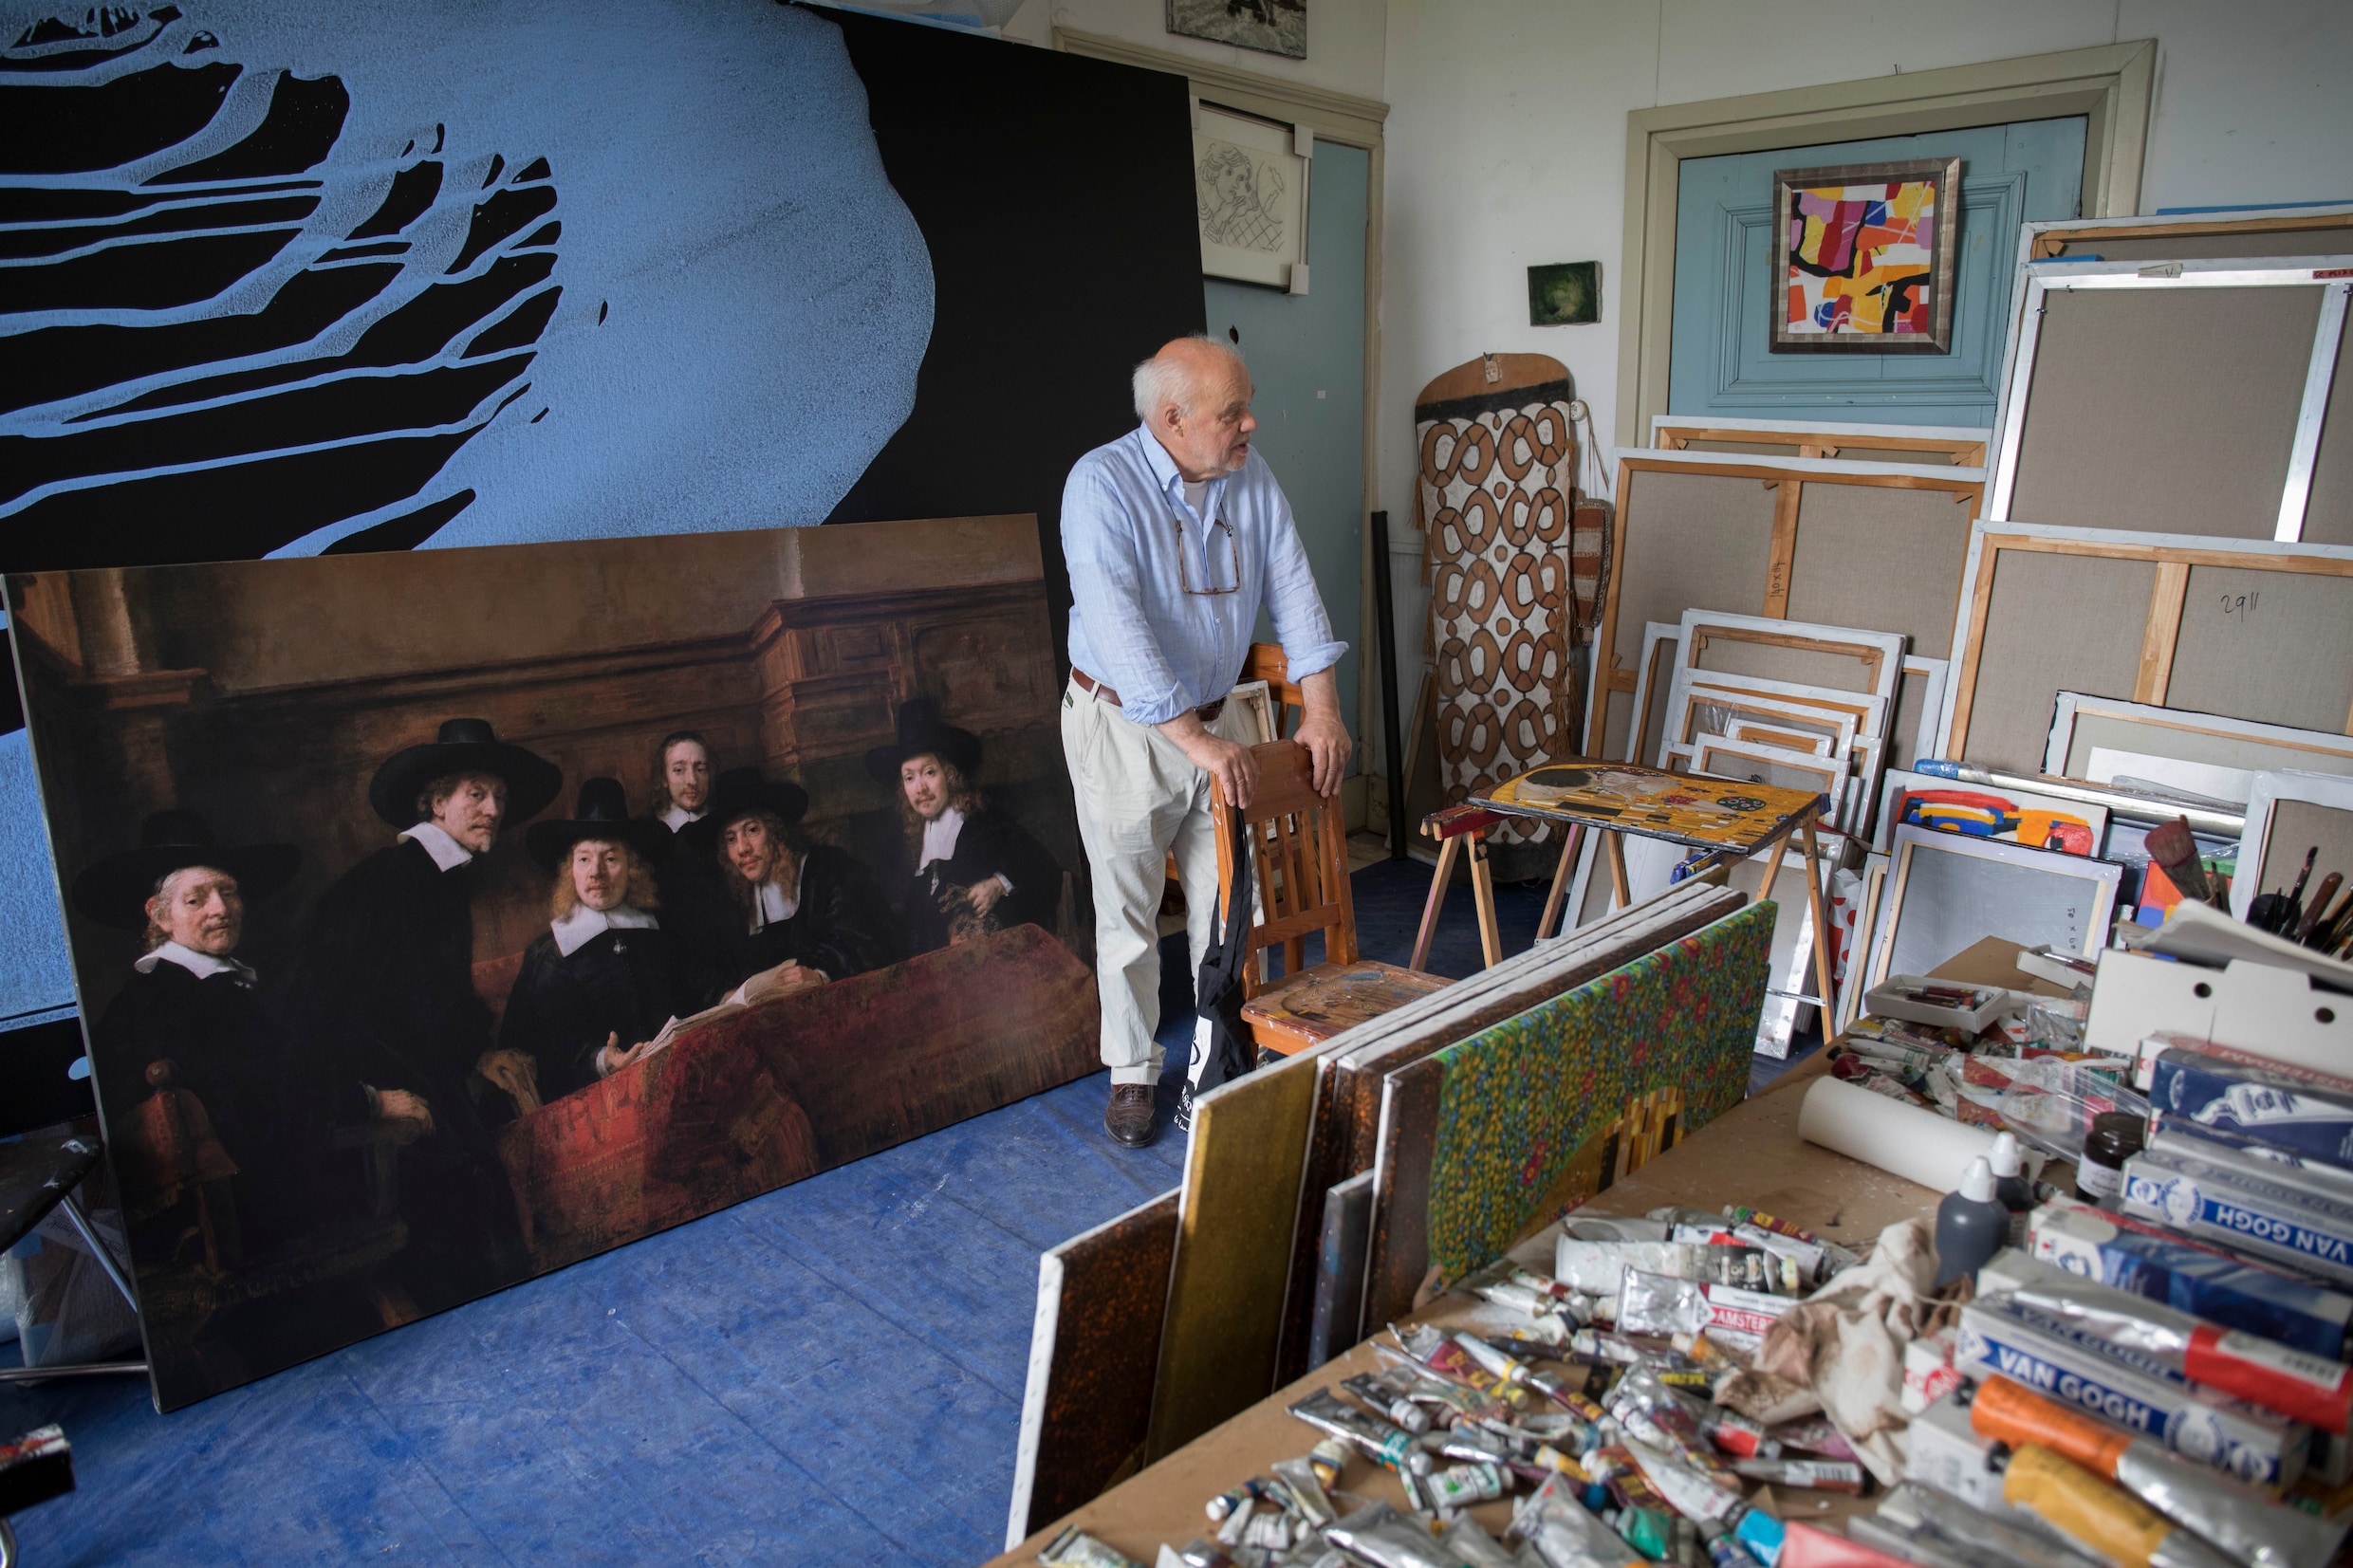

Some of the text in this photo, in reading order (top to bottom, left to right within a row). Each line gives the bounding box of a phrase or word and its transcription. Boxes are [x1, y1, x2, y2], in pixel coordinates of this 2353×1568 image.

[2220, 591, 2259, 623] 2911
[2215, 1205, 2348, 1264] VAN GOGH
[1998, 1345, 2151, 1432] VAN GOGH
